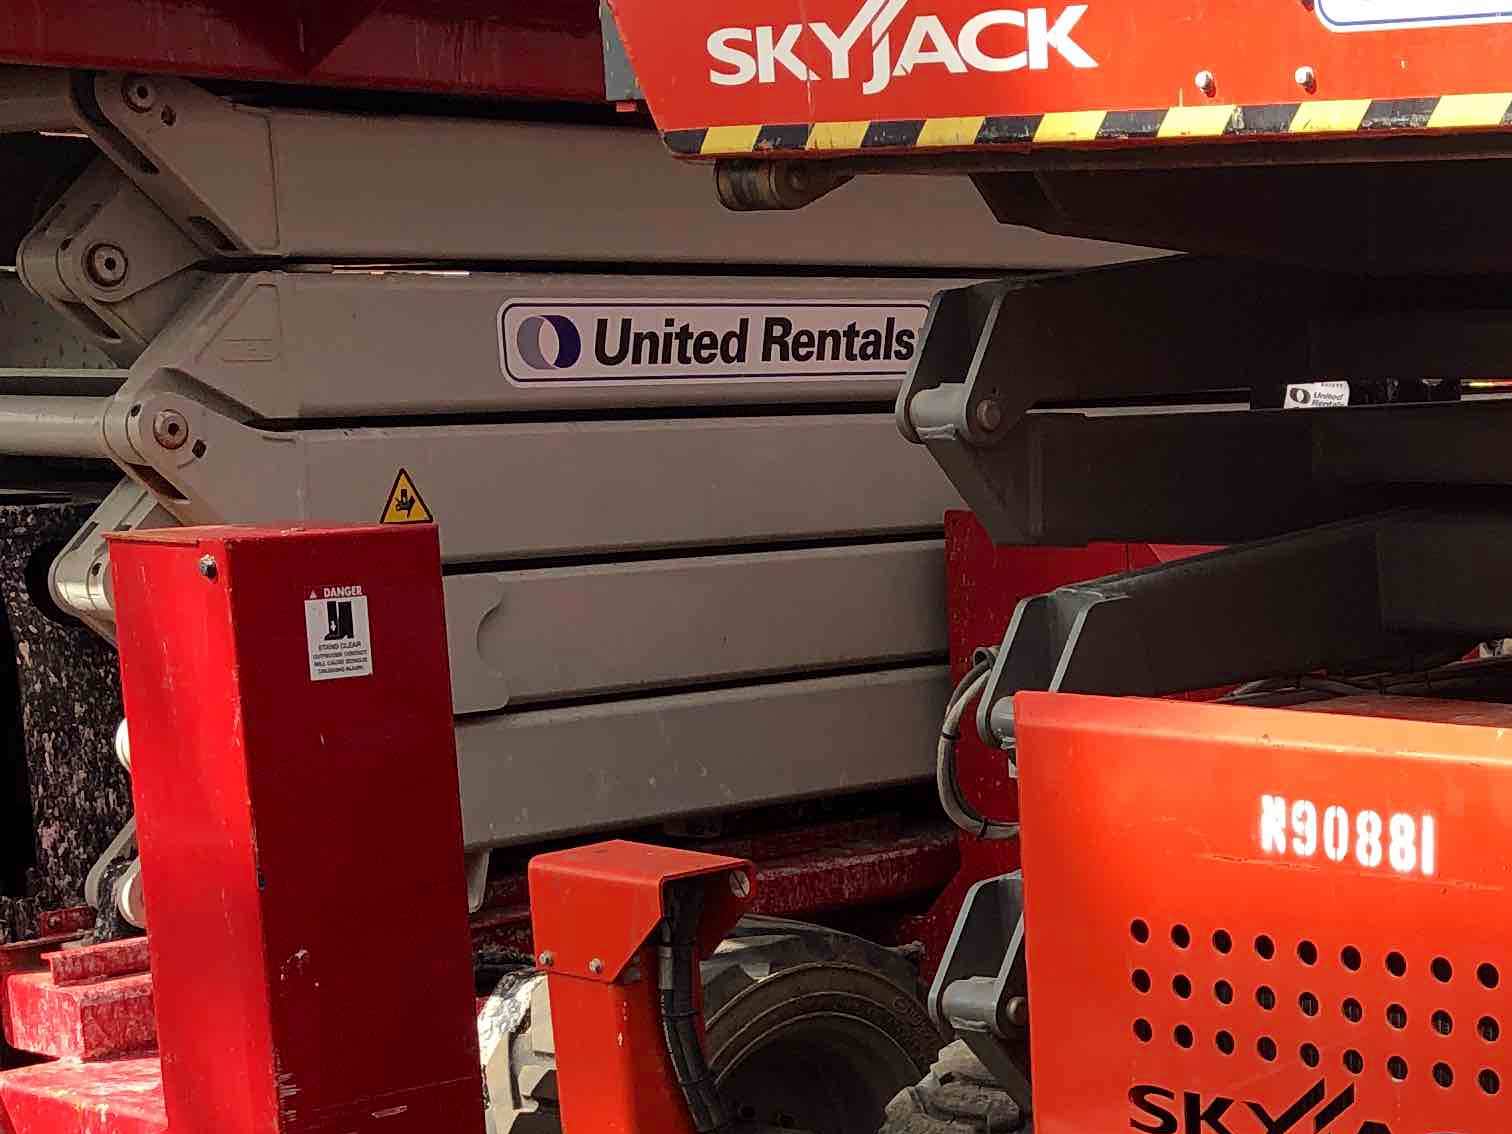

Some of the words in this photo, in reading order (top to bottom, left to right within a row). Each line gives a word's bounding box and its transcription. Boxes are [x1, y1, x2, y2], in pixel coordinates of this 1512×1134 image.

[706, 0, 1098, 95] SKYJACK
[594, 317, 750, 366] United
[761, 317, 915, 362] Rentals
[323, 585, 362, 598] DANGER
[1259, 793, 1437, 875] N90881
